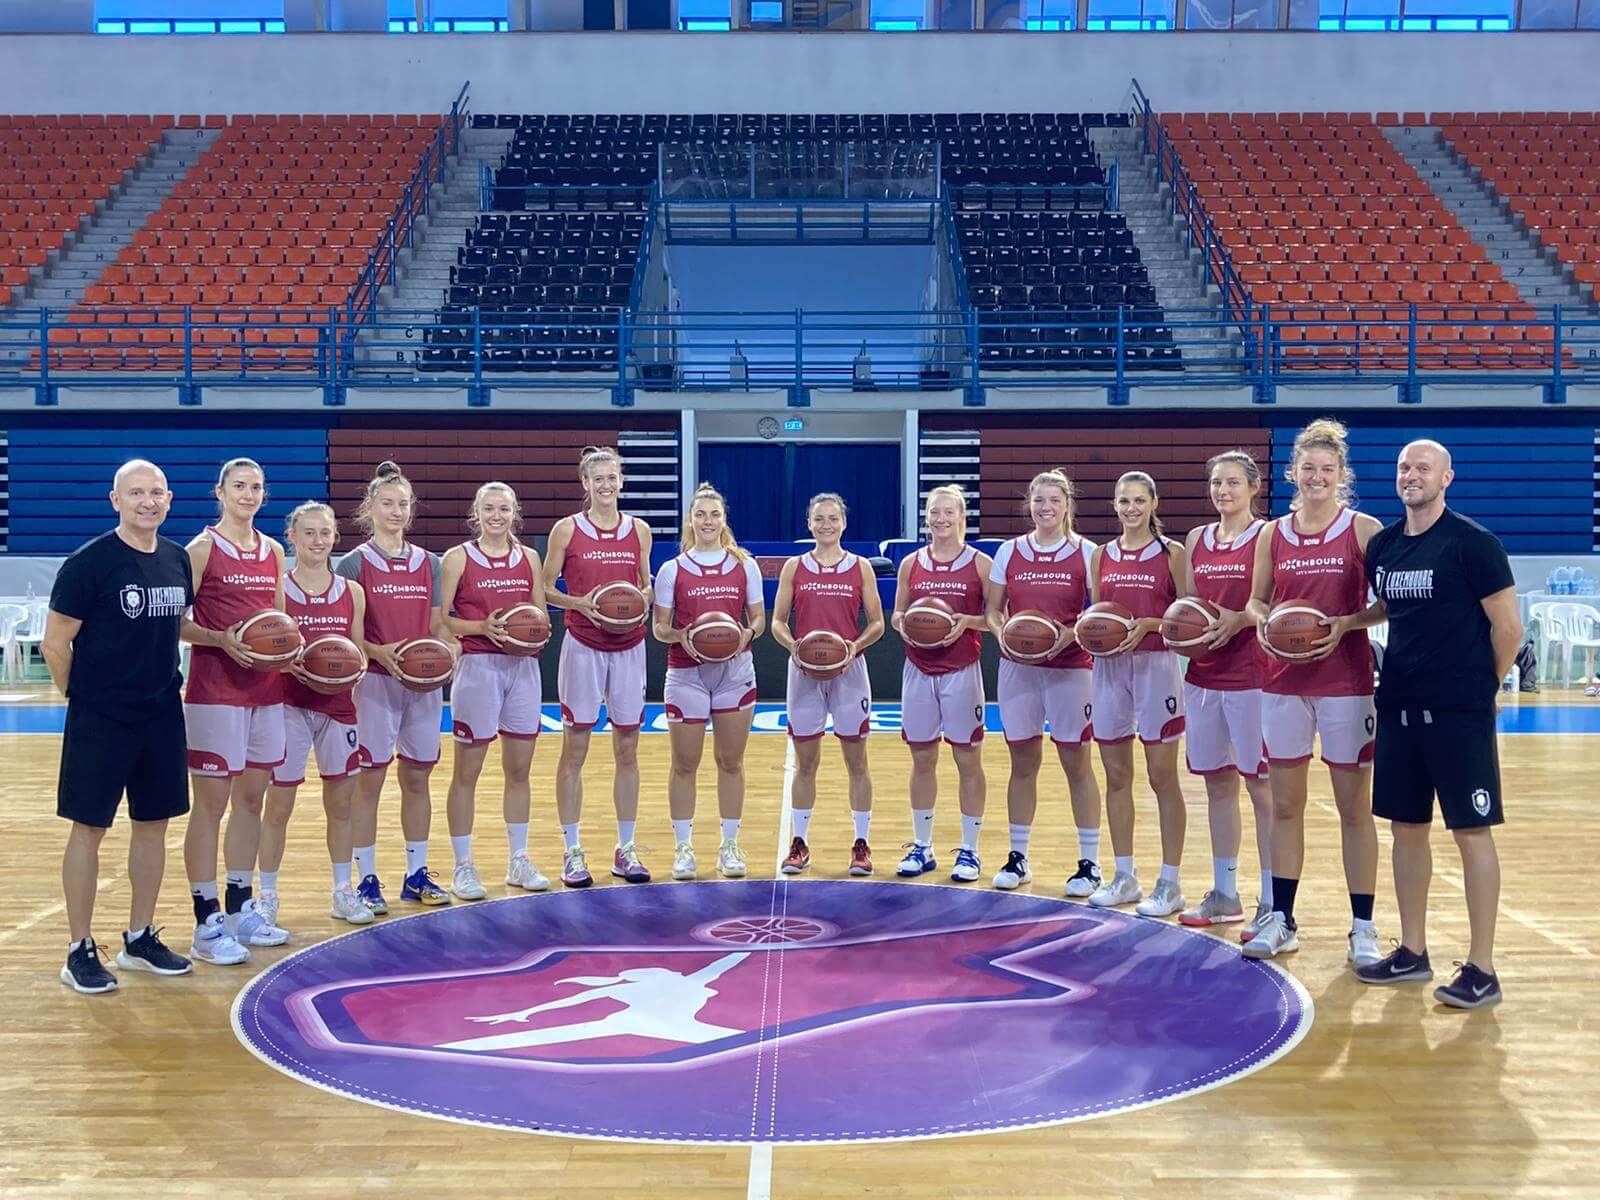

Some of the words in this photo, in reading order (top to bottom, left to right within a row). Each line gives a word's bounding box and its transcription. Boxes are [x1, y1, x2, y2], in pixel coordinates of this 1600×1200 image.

[406, 328, 413, 338] C
[1278, 558, 1344, 570] LUXEMBOURG
[1014, 572, 1072, 580] LUXEMBOURG
[800, 582, 853, 591] LUXEMBOURG
[914, 582, 967, 590] LUXEMBOURG
[687, 586, 739, 596] LUXEMBOURG
